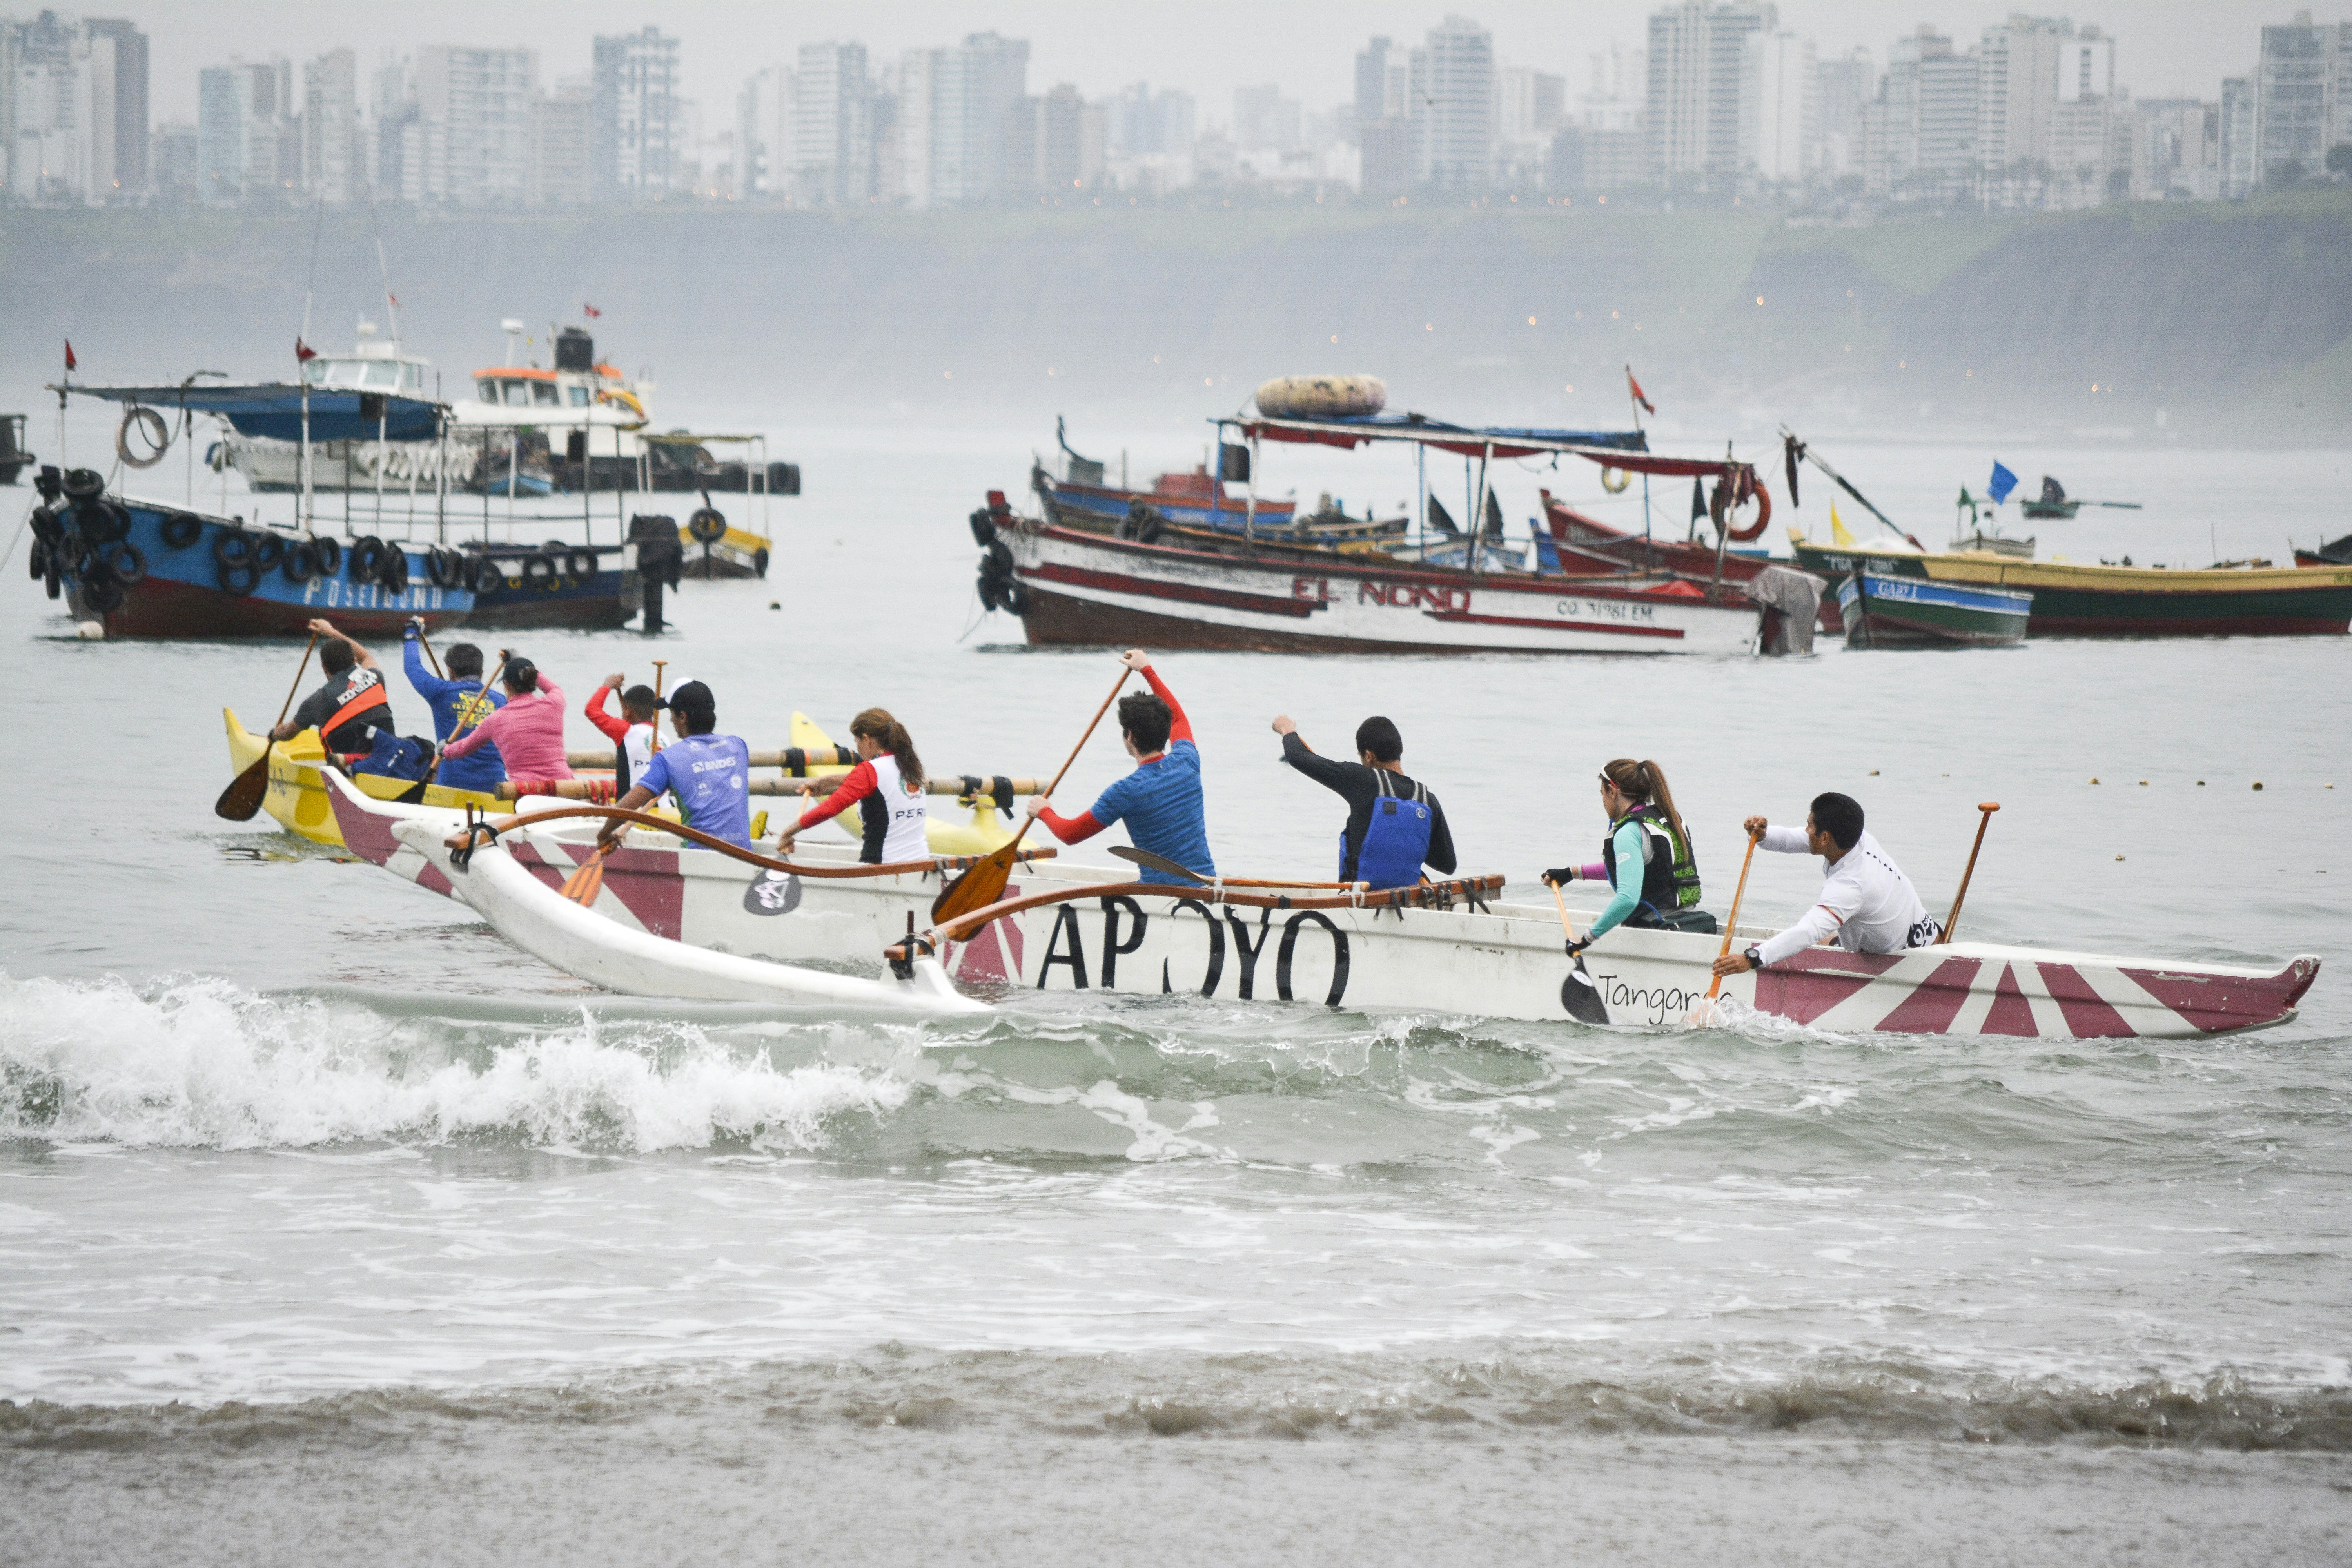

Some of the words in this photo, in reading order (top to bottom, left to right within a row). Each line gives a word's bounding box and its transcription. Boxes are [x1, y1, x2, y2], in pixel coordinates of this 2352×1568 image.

[1293, 577, 1341, 602] EL
[1359, 581, 1470, 612] NONO
[705, 756, 737, 770] BNDES
[1037, 895, 1350, 1007] APOYO
